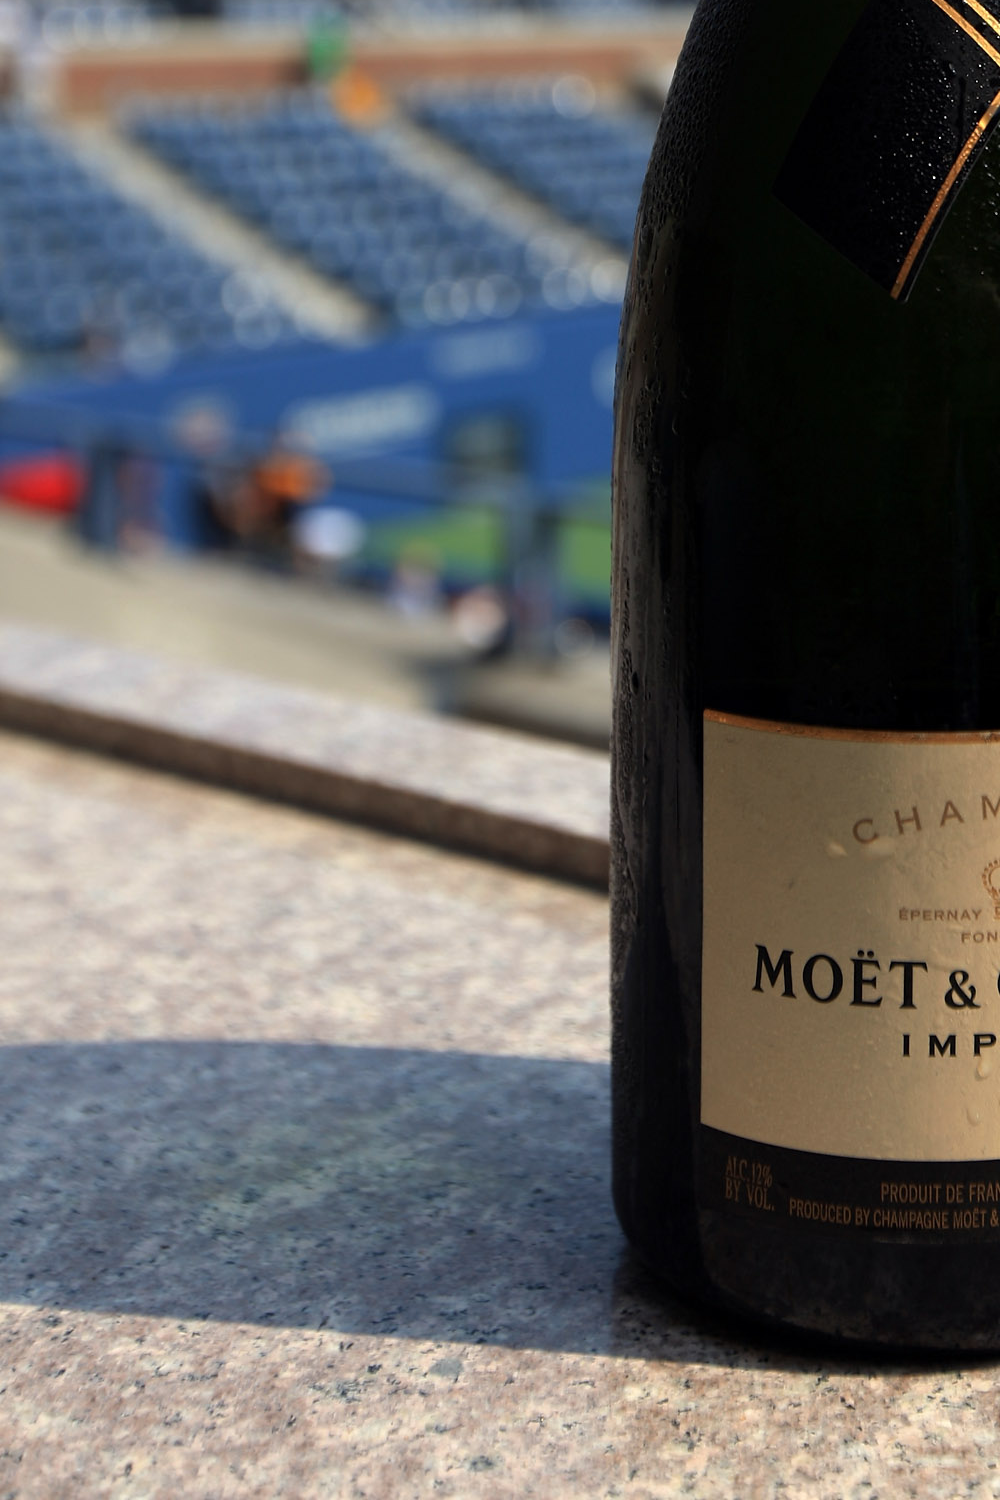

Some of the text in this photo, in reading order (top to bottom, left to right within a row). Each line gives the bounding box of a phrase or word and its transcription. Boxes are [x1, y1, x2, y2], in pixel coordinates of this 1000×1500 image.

[899, 906, 983, 922] ÉPERNAY
[751, 943, 928, 1010] MOËT
[943, 968, 981, 1010] &
[725, 1177, 741, 1203] BY
[880, 1181, 942, 1204] PRODUIT
[946, 1183, 965, 1204] DE
[789, 1197, 851, 1226] PRODUCED
[855, 1207, 872, 1227] BY
[873, 1208, 950, 1230] CHAMPAGNE
[953, 1207, 987, 1230] MOËT
[989, 1210, 1000, 1228] &
